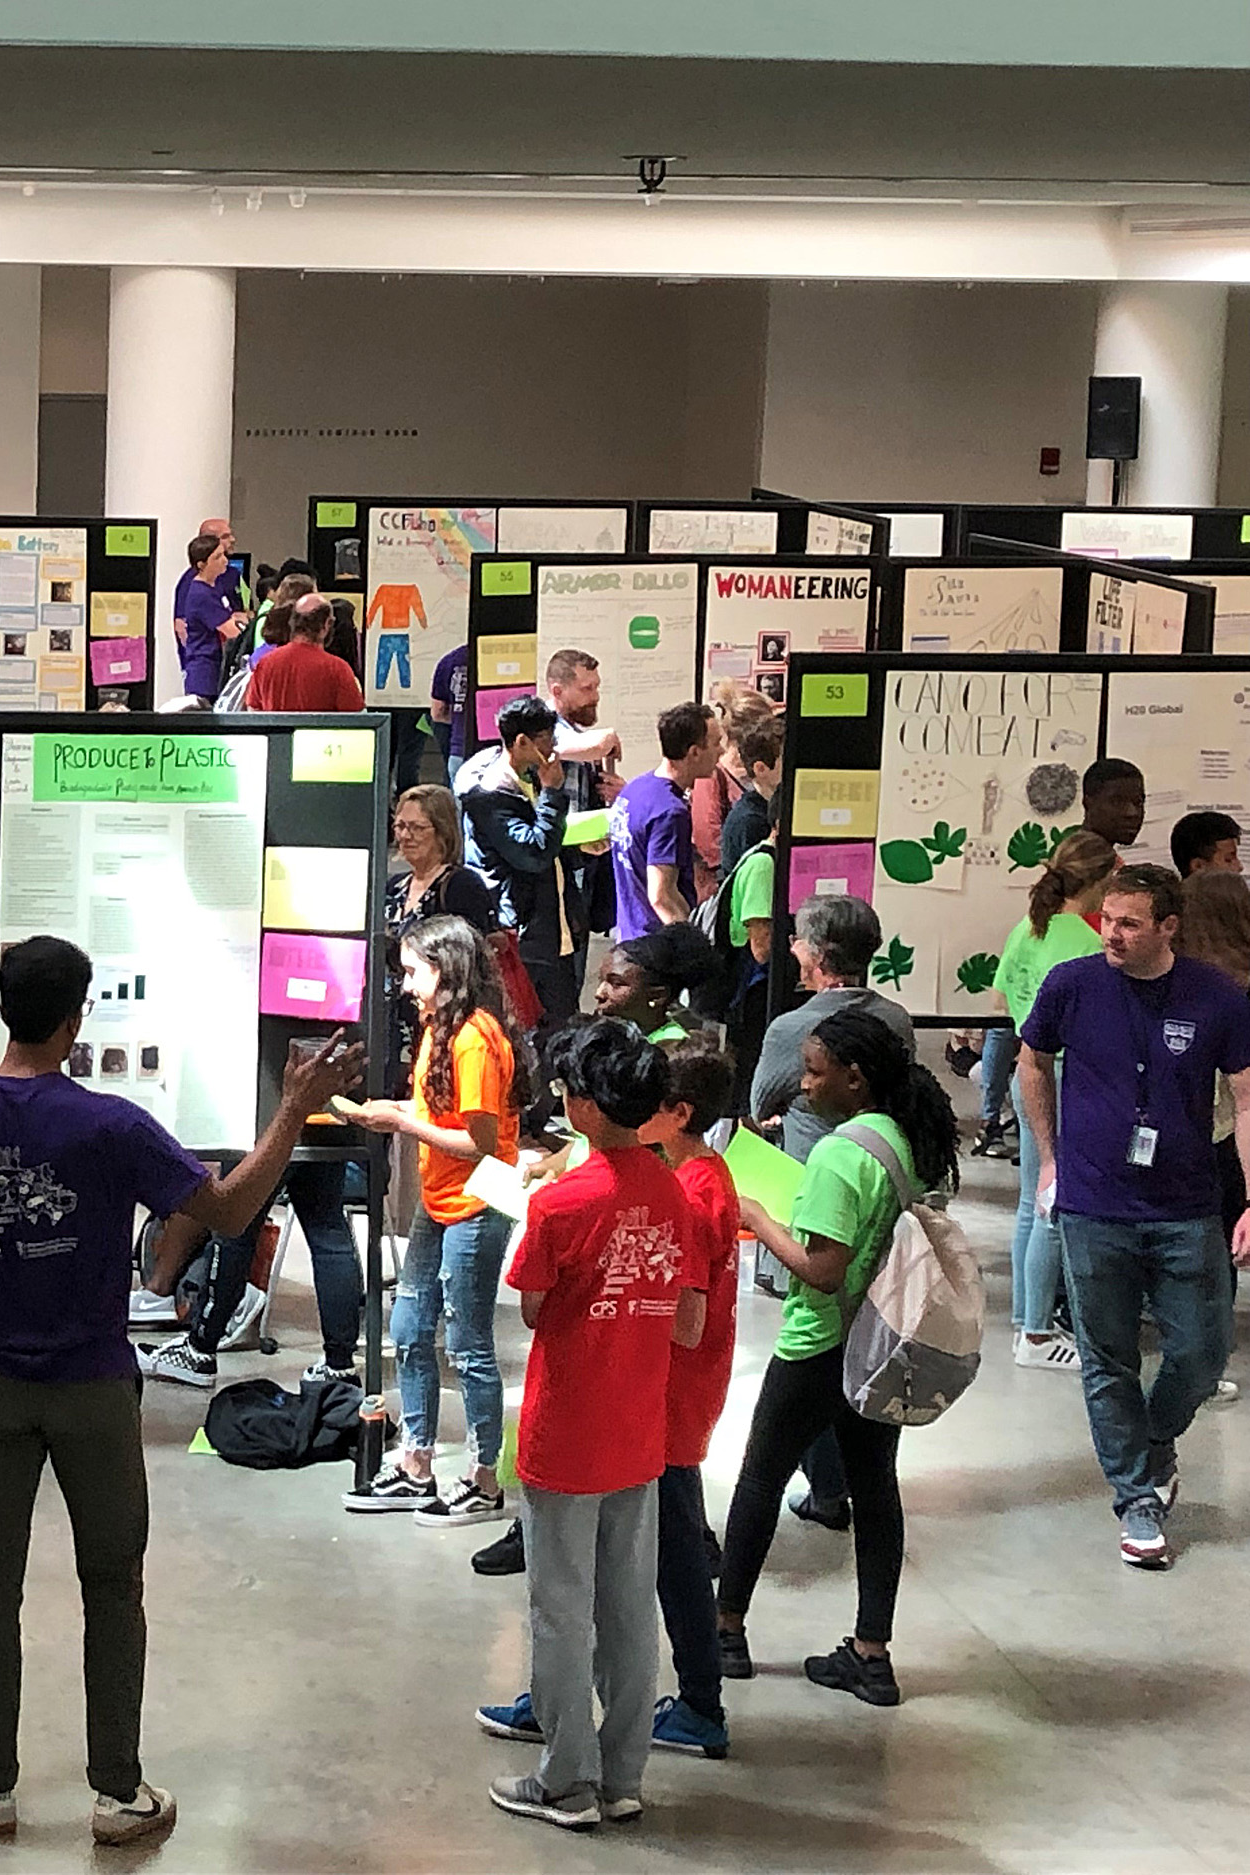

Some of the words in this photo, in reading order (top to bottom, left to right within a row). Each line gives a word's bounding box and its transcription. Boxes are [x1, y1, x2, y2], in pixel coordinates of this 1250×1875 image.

[121, 534, 134, 543] 43
[540, 571, 622, 595] ARMOR
[715, 572, 868, 600] WOMANEERING
[826, 685, 845, 699] 53
[1000, 673, 1076, 717] FOR
[1149, 704, 1183, 715] Global
[899, 714, 1050, 758] COMBAT
[54, 743, 141, 783] PRODUCE
[160, 738, 237, 782] PLASTIC
[323, 745, 343, 757] 41
[590, 1300, 618, 1315] CPS
